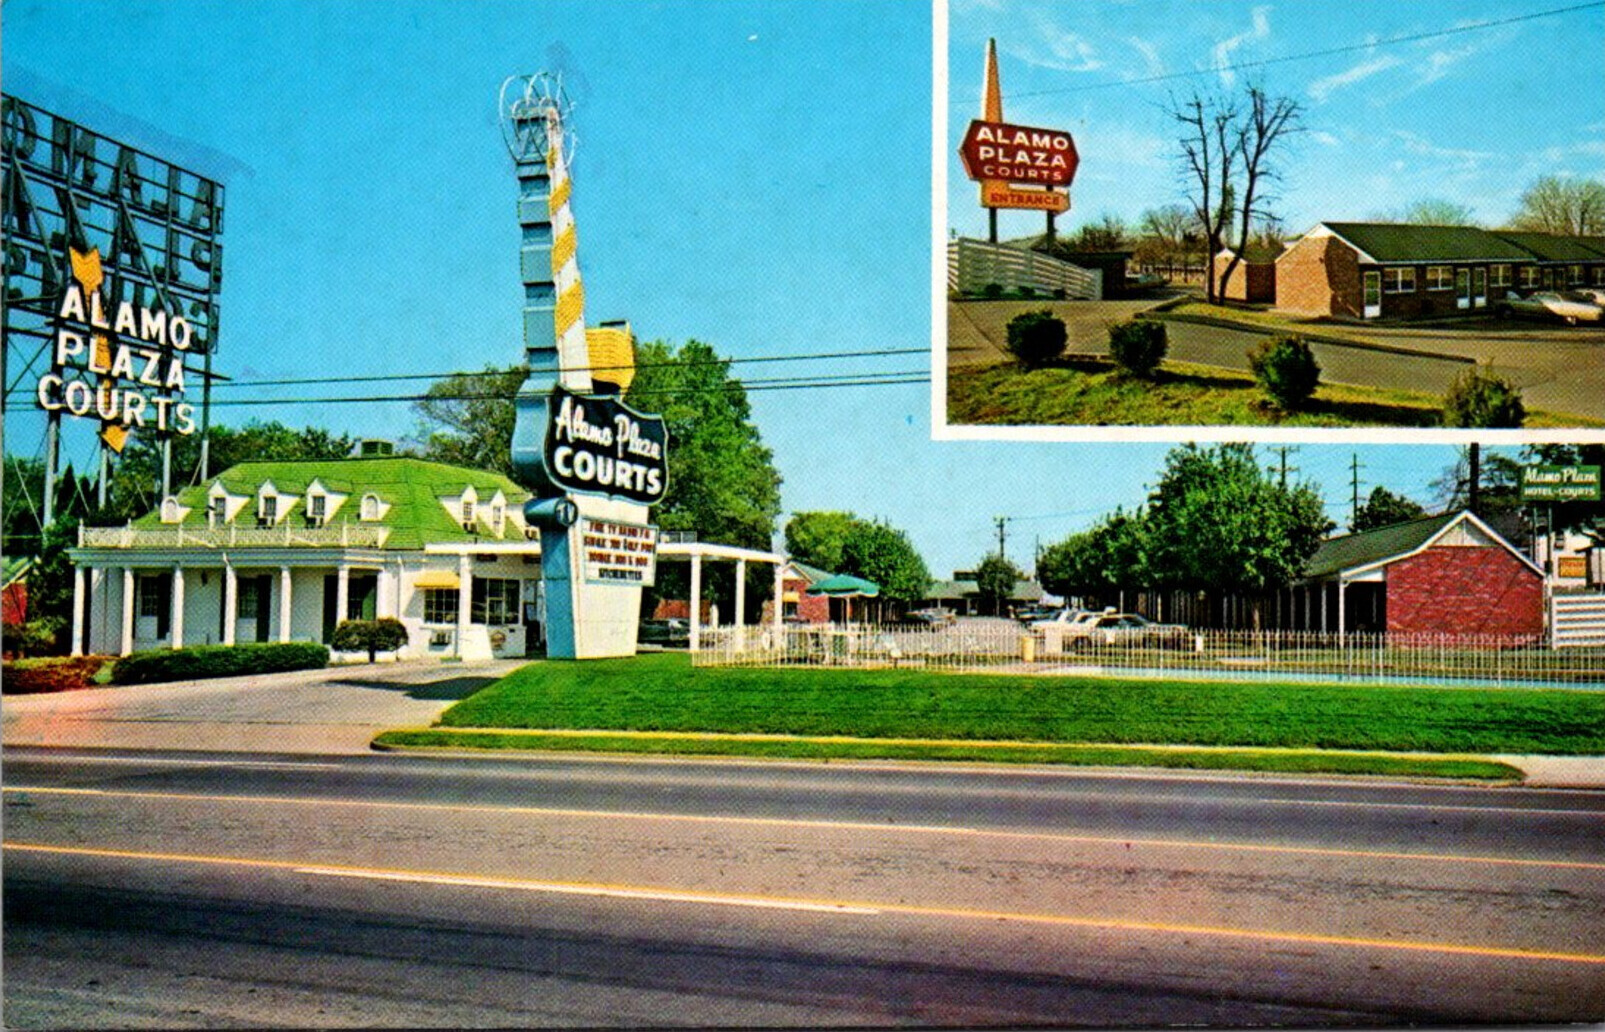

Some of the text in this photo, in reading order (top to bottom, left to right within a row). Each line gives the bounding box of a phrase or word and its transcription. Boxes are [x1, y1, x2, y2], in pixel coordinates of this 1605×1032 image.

[976, 126, 1069, 150] ALAMO
[979, 146, 1067, 168] PLAZA
[983, 165, 1063, 180] COURTS
[990, 192, 1060, 206] ENTRANCE
[60, 285, 191, 350] ALAMO
[57, 330, 185, 393] PLAZA
[38, 374, 196, 436] COURTS
[555, 396, 661, 460] Alamo Plaza
[554, 446, 662, 495] COURTS
[1523, 466, 1597, 483] Alamo Plaza
